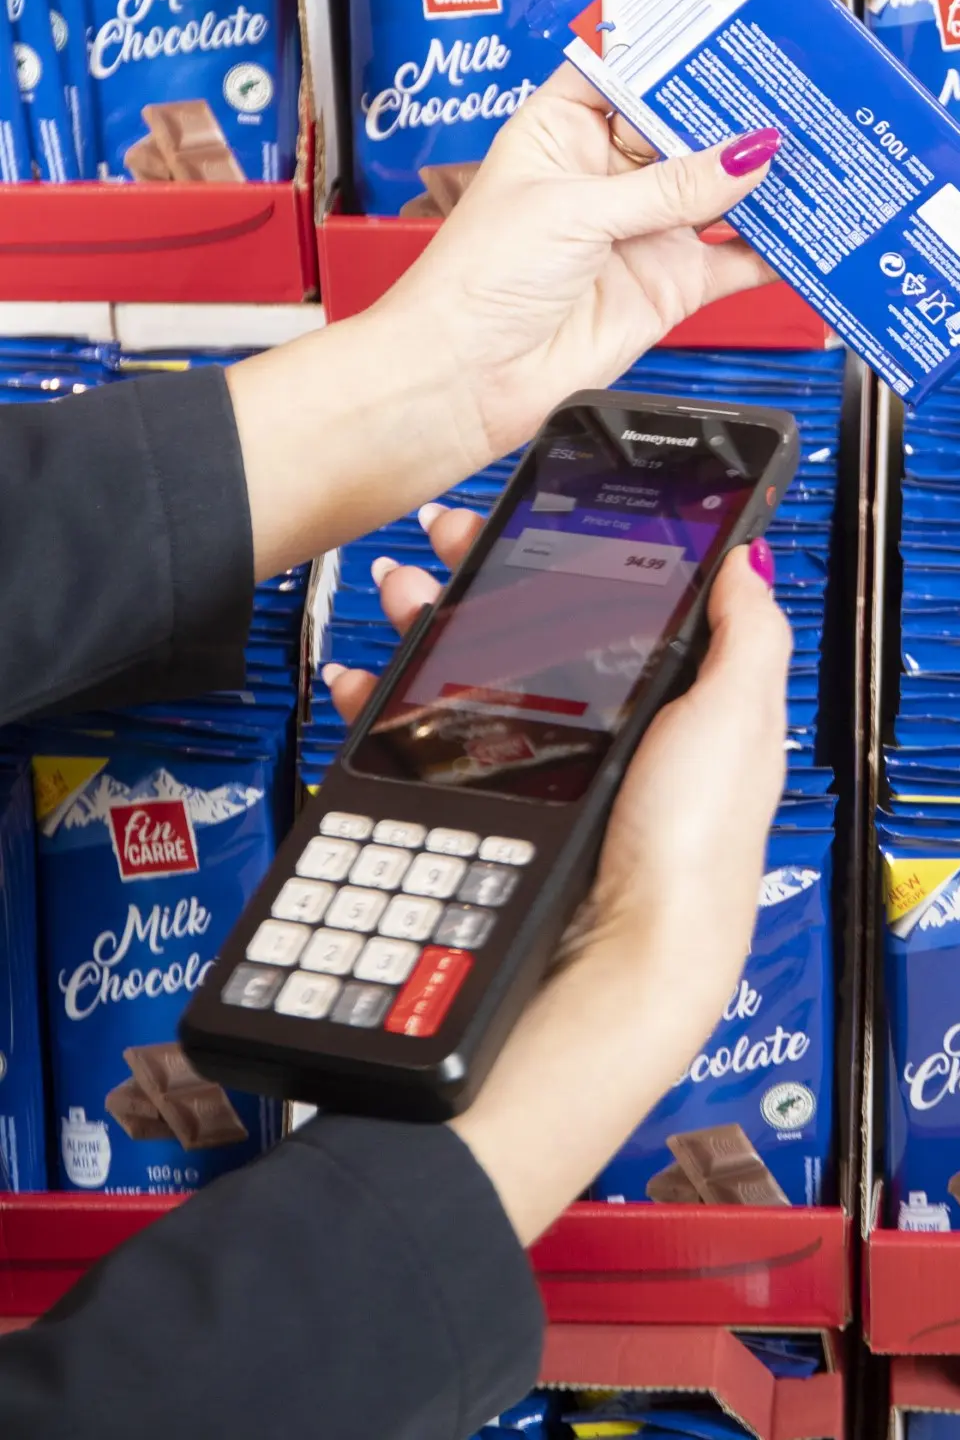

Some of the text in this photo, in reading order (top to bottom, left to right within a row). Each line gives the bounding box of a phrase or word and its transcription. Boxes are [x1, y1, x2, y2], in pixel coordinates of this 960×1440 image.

[87, 5, 267, 79] Chocolate
[395, 35, 511, 94] Milk
[361, 78, 540, 141] Chocolat
[621, 430, 698, 447] Honeywell
[125, 810, 175, 859] fin
[128, 835, 188, 866] CARRÉ
[888, 873, 920, 904] NEW
[93, 896, 211, 967] Milk
[59, 954, 216, 1020] Chocol
[146, 1165, 170, 1182] 100
